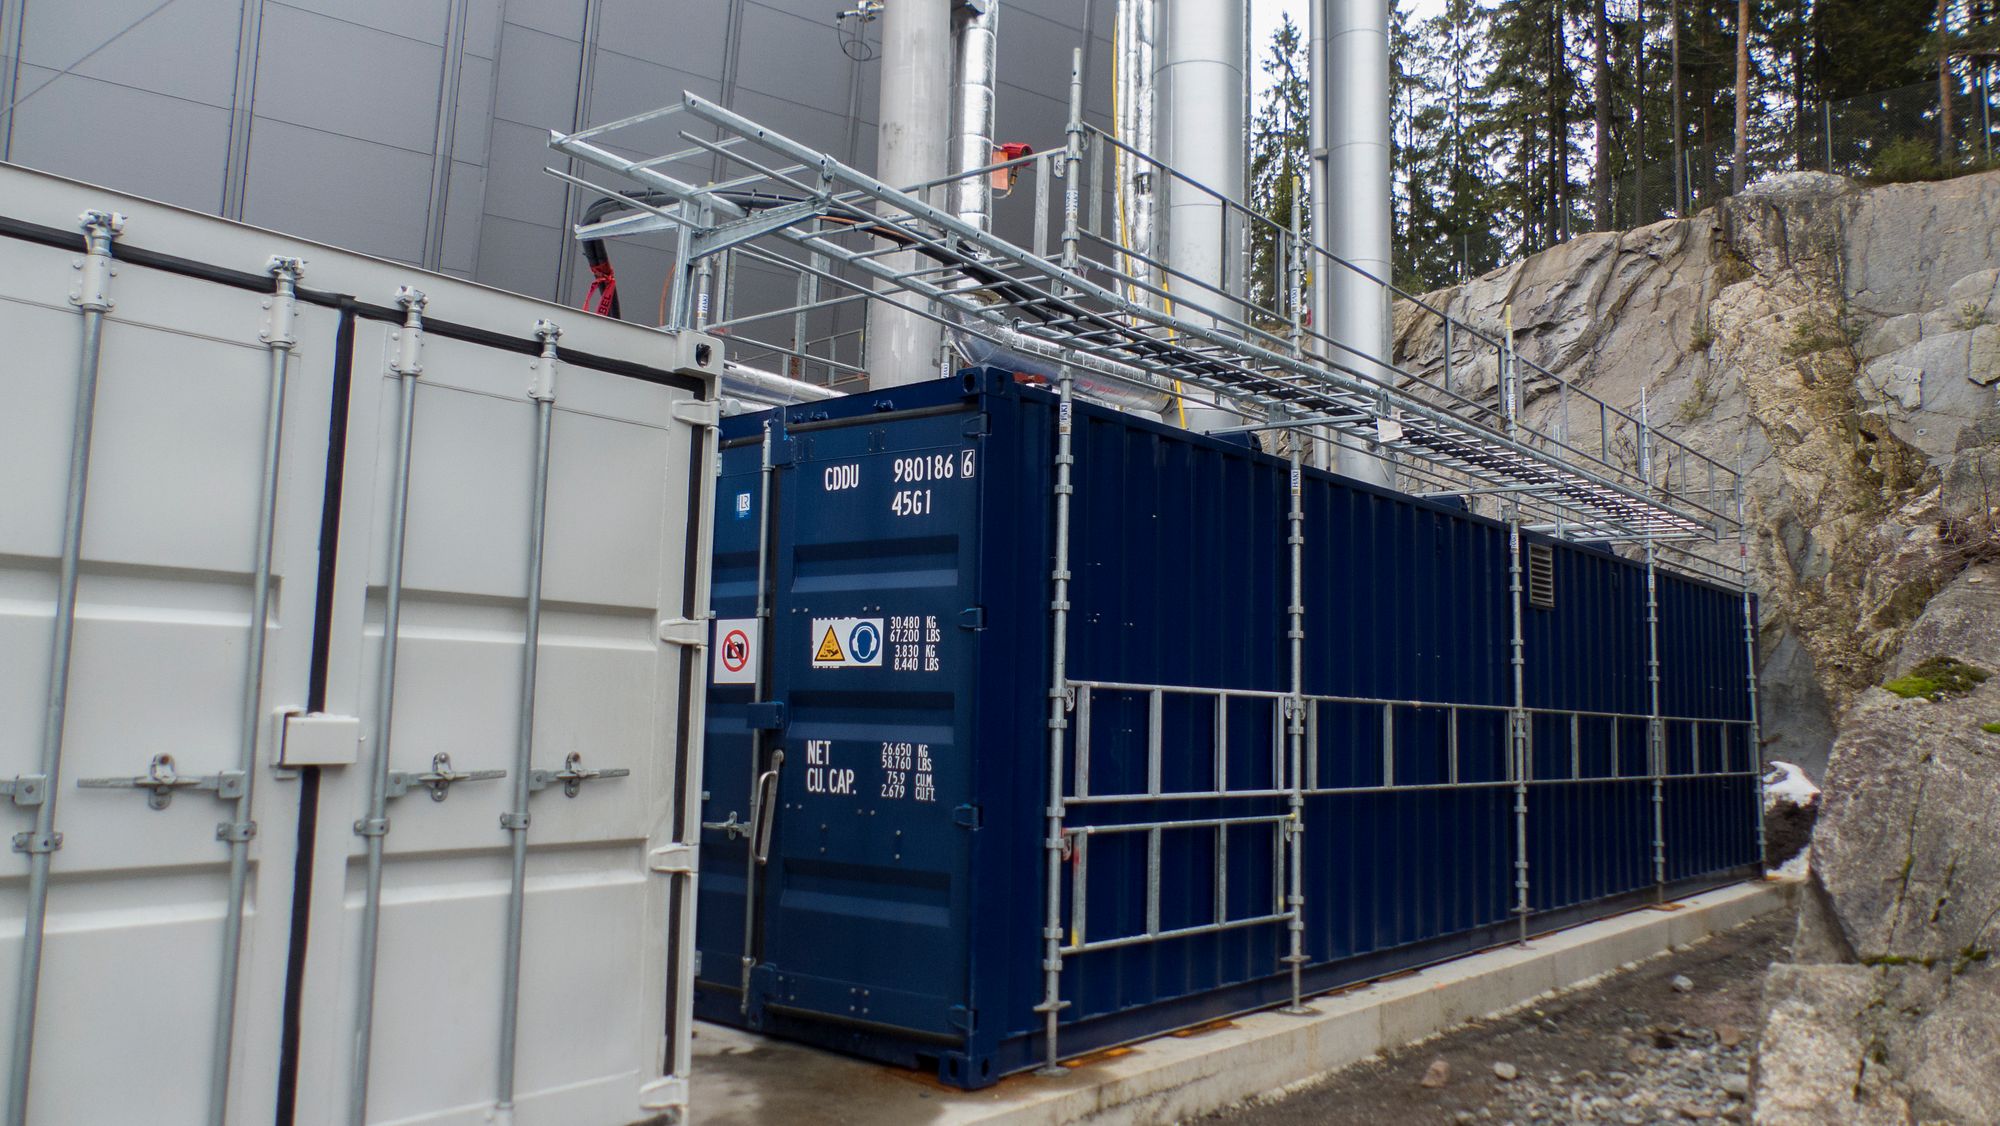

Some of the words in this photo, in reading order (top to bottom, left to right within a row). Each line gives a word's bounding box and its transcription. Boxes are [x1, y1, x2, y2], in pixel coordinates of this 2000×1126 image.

[825, 463, 860, 491] CDDU
[894, 453, 954, 483] 980186
[962, 451, 974, 477] 6
[891, 489, 931, 516] 45G1
[890, 616, 920, 629] 30.480
[926, 615, 937, 629] KG
[889, 629, 920, 643] 67.200
[926, 629, 940, 643] LBS
[895, 644, 919, 658] 3.830
[925, 645, 936, 658] KG
[894, 658, 919, 671] 8.440
[925, 658, 939, 671] LBS
[807, 740, 832, 765] NET
[882, 742, 912, 757] 26.650
[918, 744, 928, 758] KG
[881, 755, 912, 770] 58.760
[917, 757, 932, 772] LBS
[807, 767, 826, 793] CU.
[829, 768, 857, 795] CAP.
[887, 770, 906, 785] 75.9
[881, 784, 905, 799] 2.679
